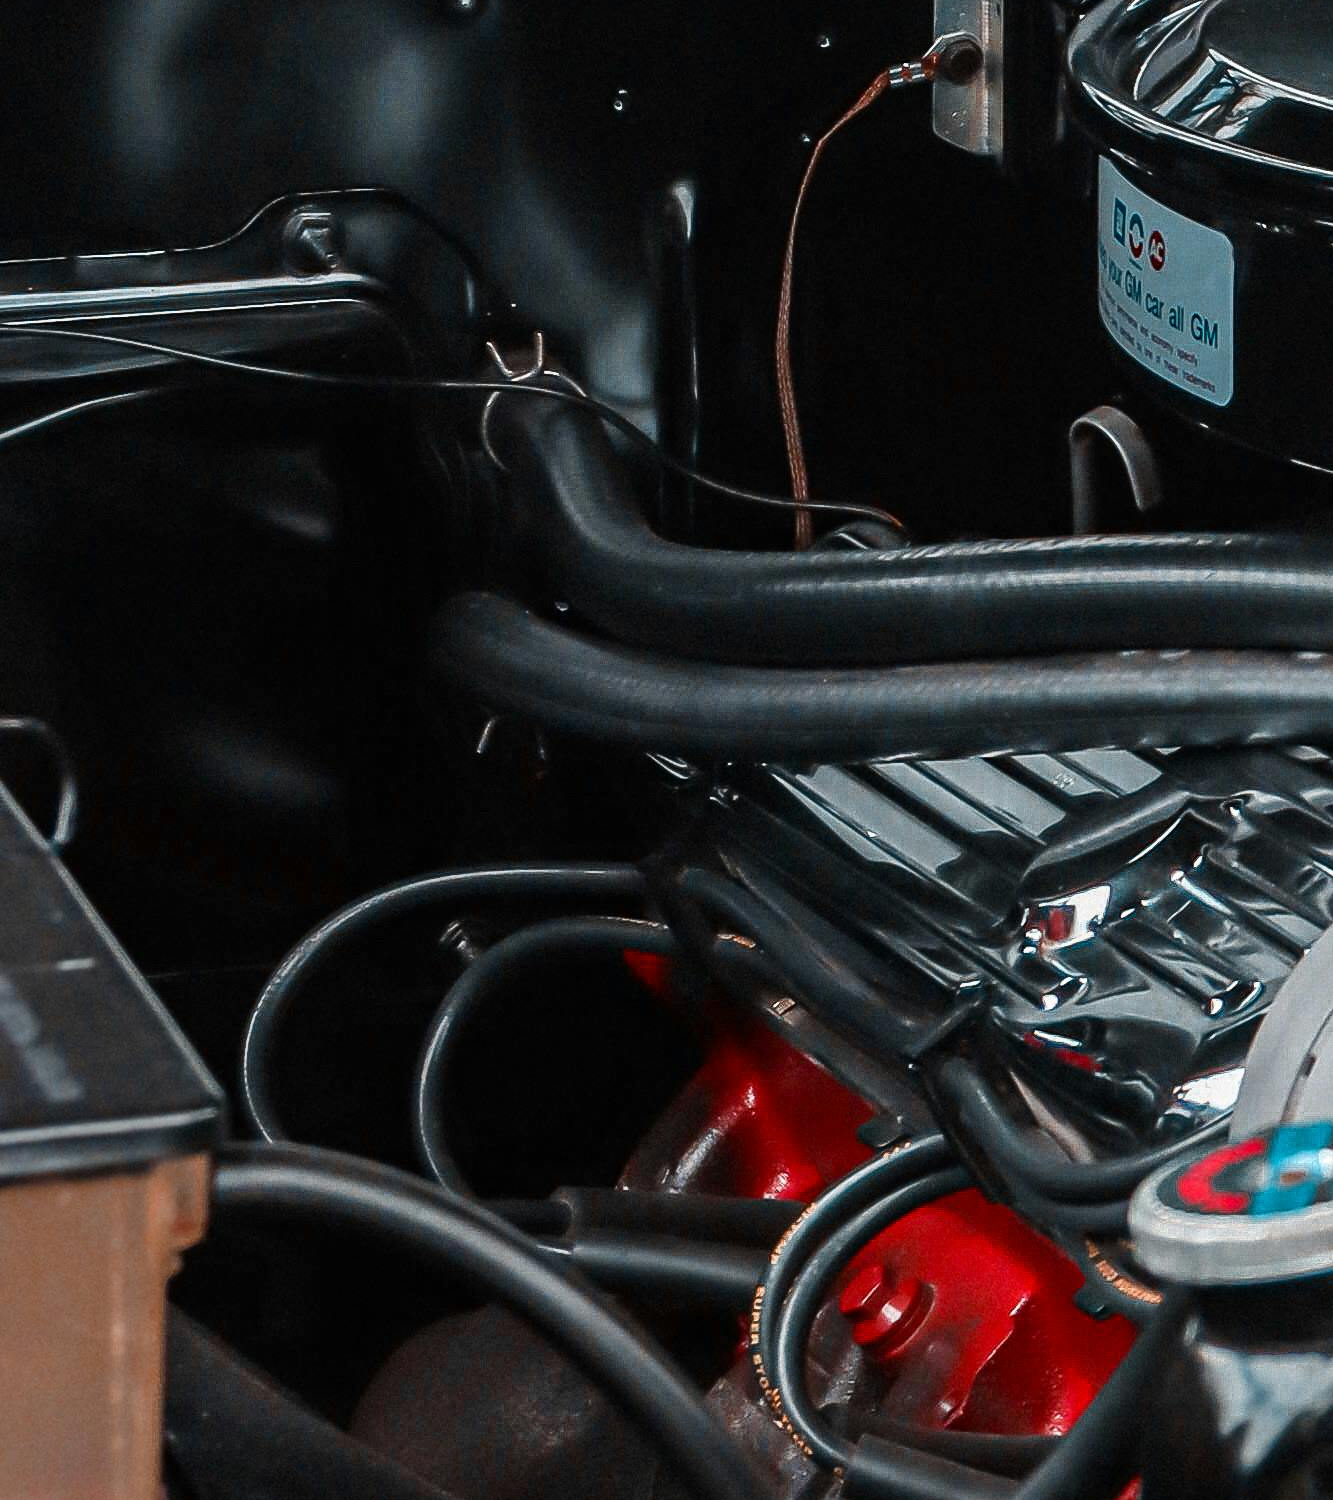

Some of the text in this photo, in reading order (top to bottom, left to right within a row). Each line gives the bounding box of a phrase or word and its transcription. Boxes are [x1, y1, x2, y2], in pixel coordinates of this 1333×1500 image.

[1125, 270, 1142, 305] GM
[1145, 292, 1165, 319] car
[1168, 304, 1184, 332] all
[1191, 313, 1218, 349] GM
